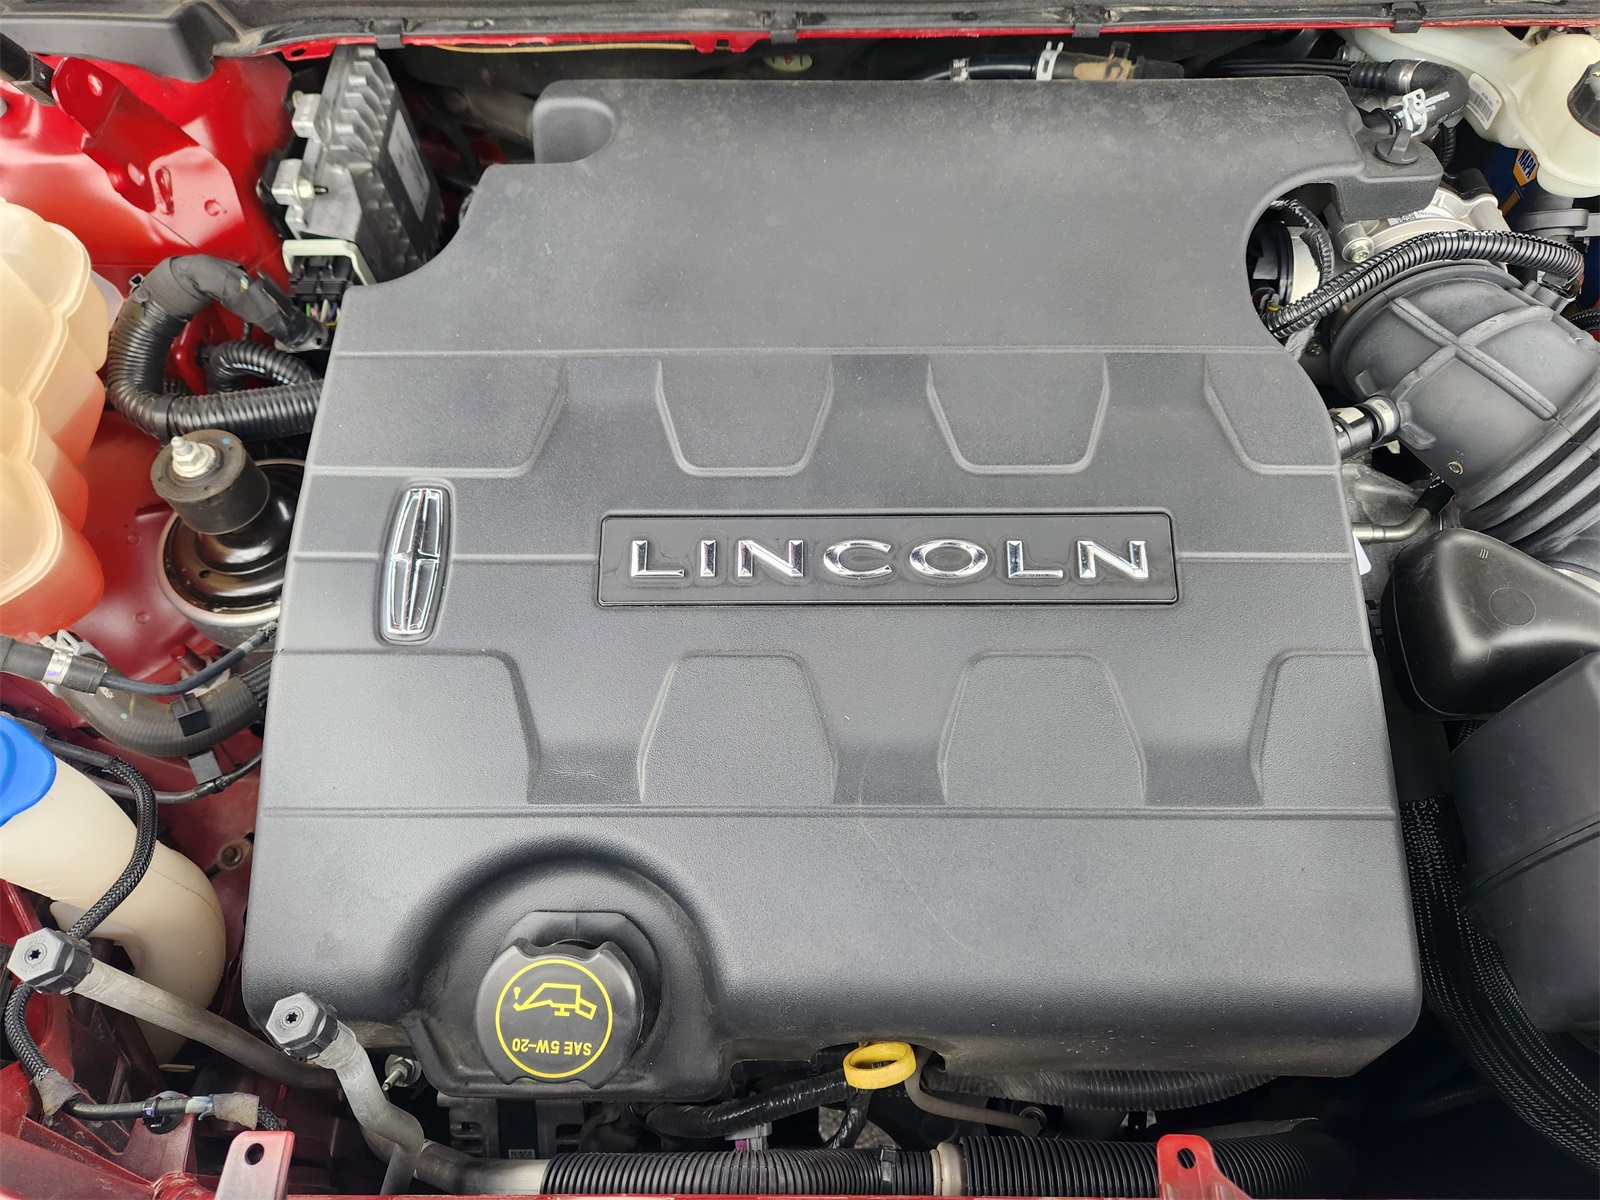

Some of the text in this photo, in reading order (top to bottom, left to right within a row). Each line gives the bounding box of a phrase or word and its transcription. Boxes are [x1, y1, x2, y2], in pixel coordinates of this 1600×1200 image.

[1517, 149, 1537, 179] NAPA
[631, 539, 1148, 579] LINCOLN
[511, 1038, 592, 1056] SAE 5W-20
